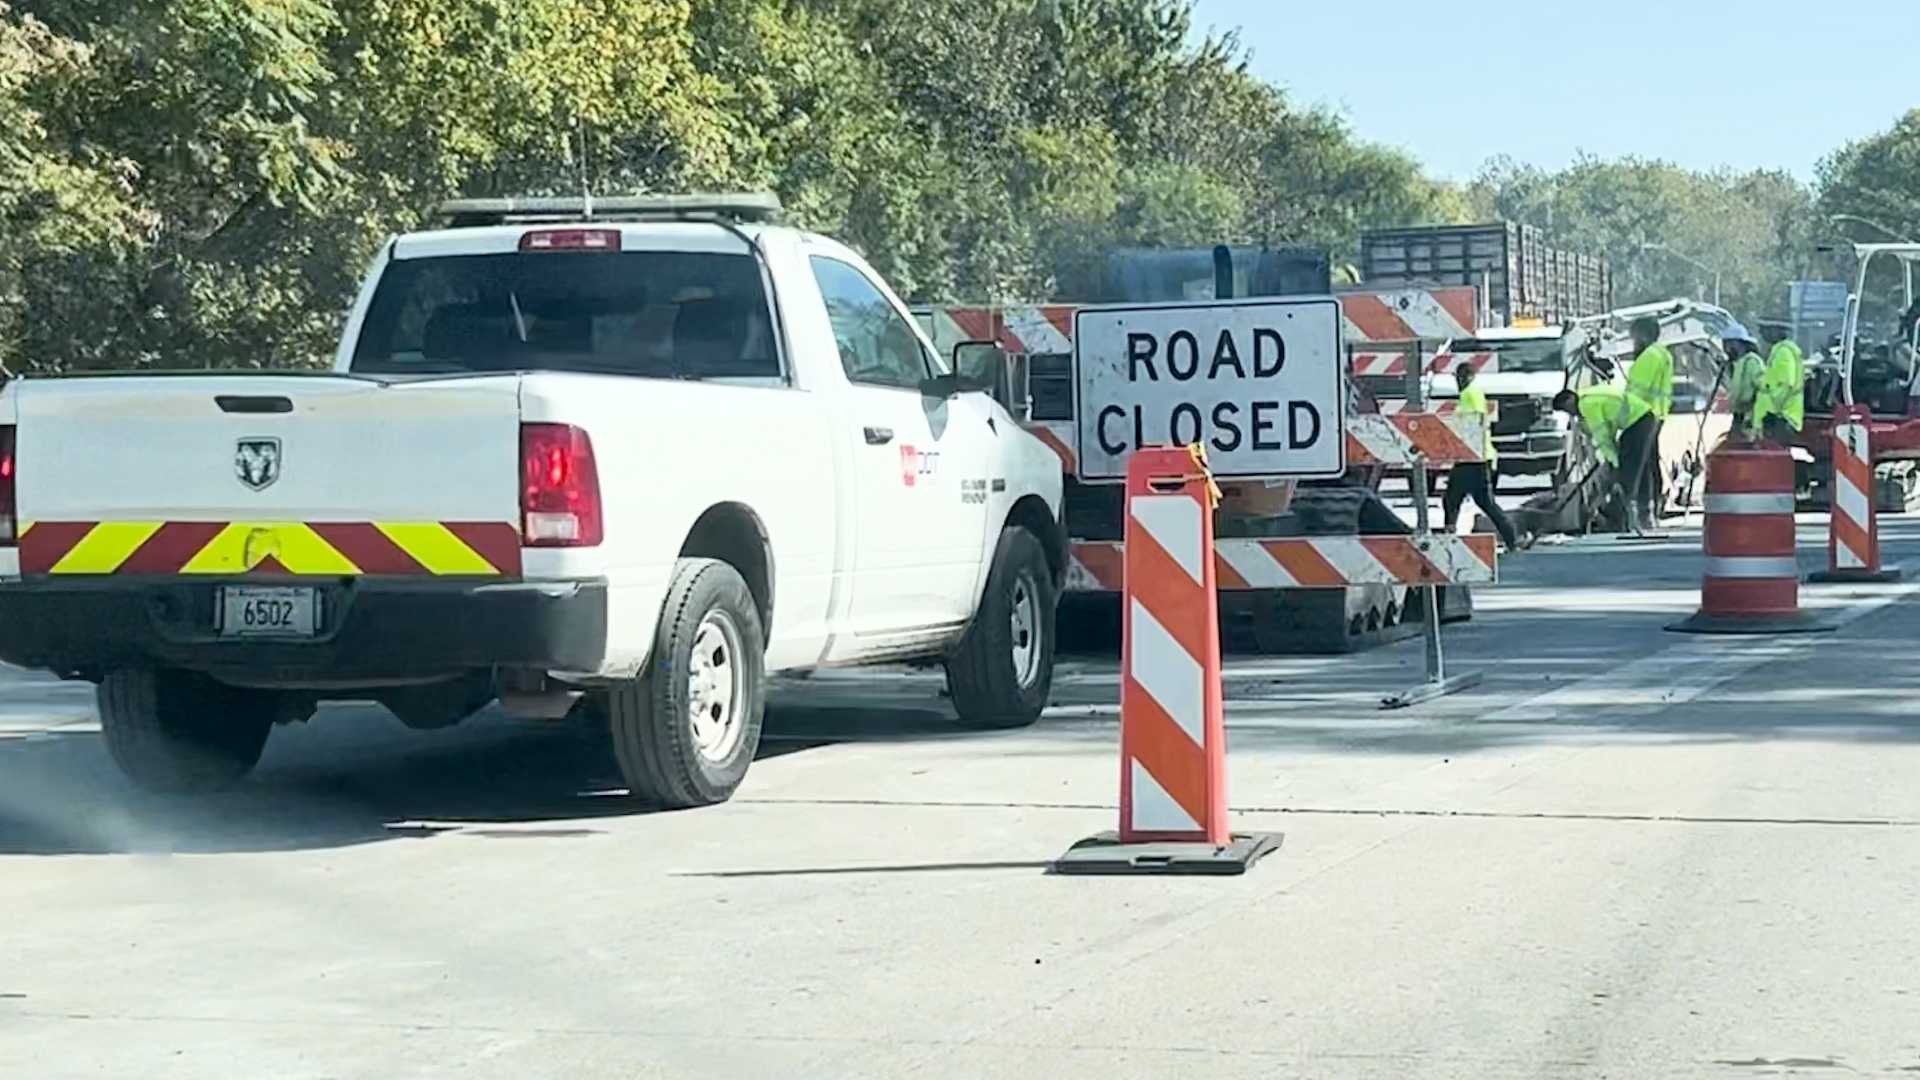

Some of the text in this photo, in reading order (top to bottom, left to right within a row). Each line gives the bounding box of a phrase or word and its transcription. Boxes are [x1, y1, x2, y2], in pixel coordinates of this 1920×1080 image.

[1127, 328, 1285, 382] ROAD
[1097, 400, 1321, 456] CLOSED
[244, 600, 294, 626] 6502
